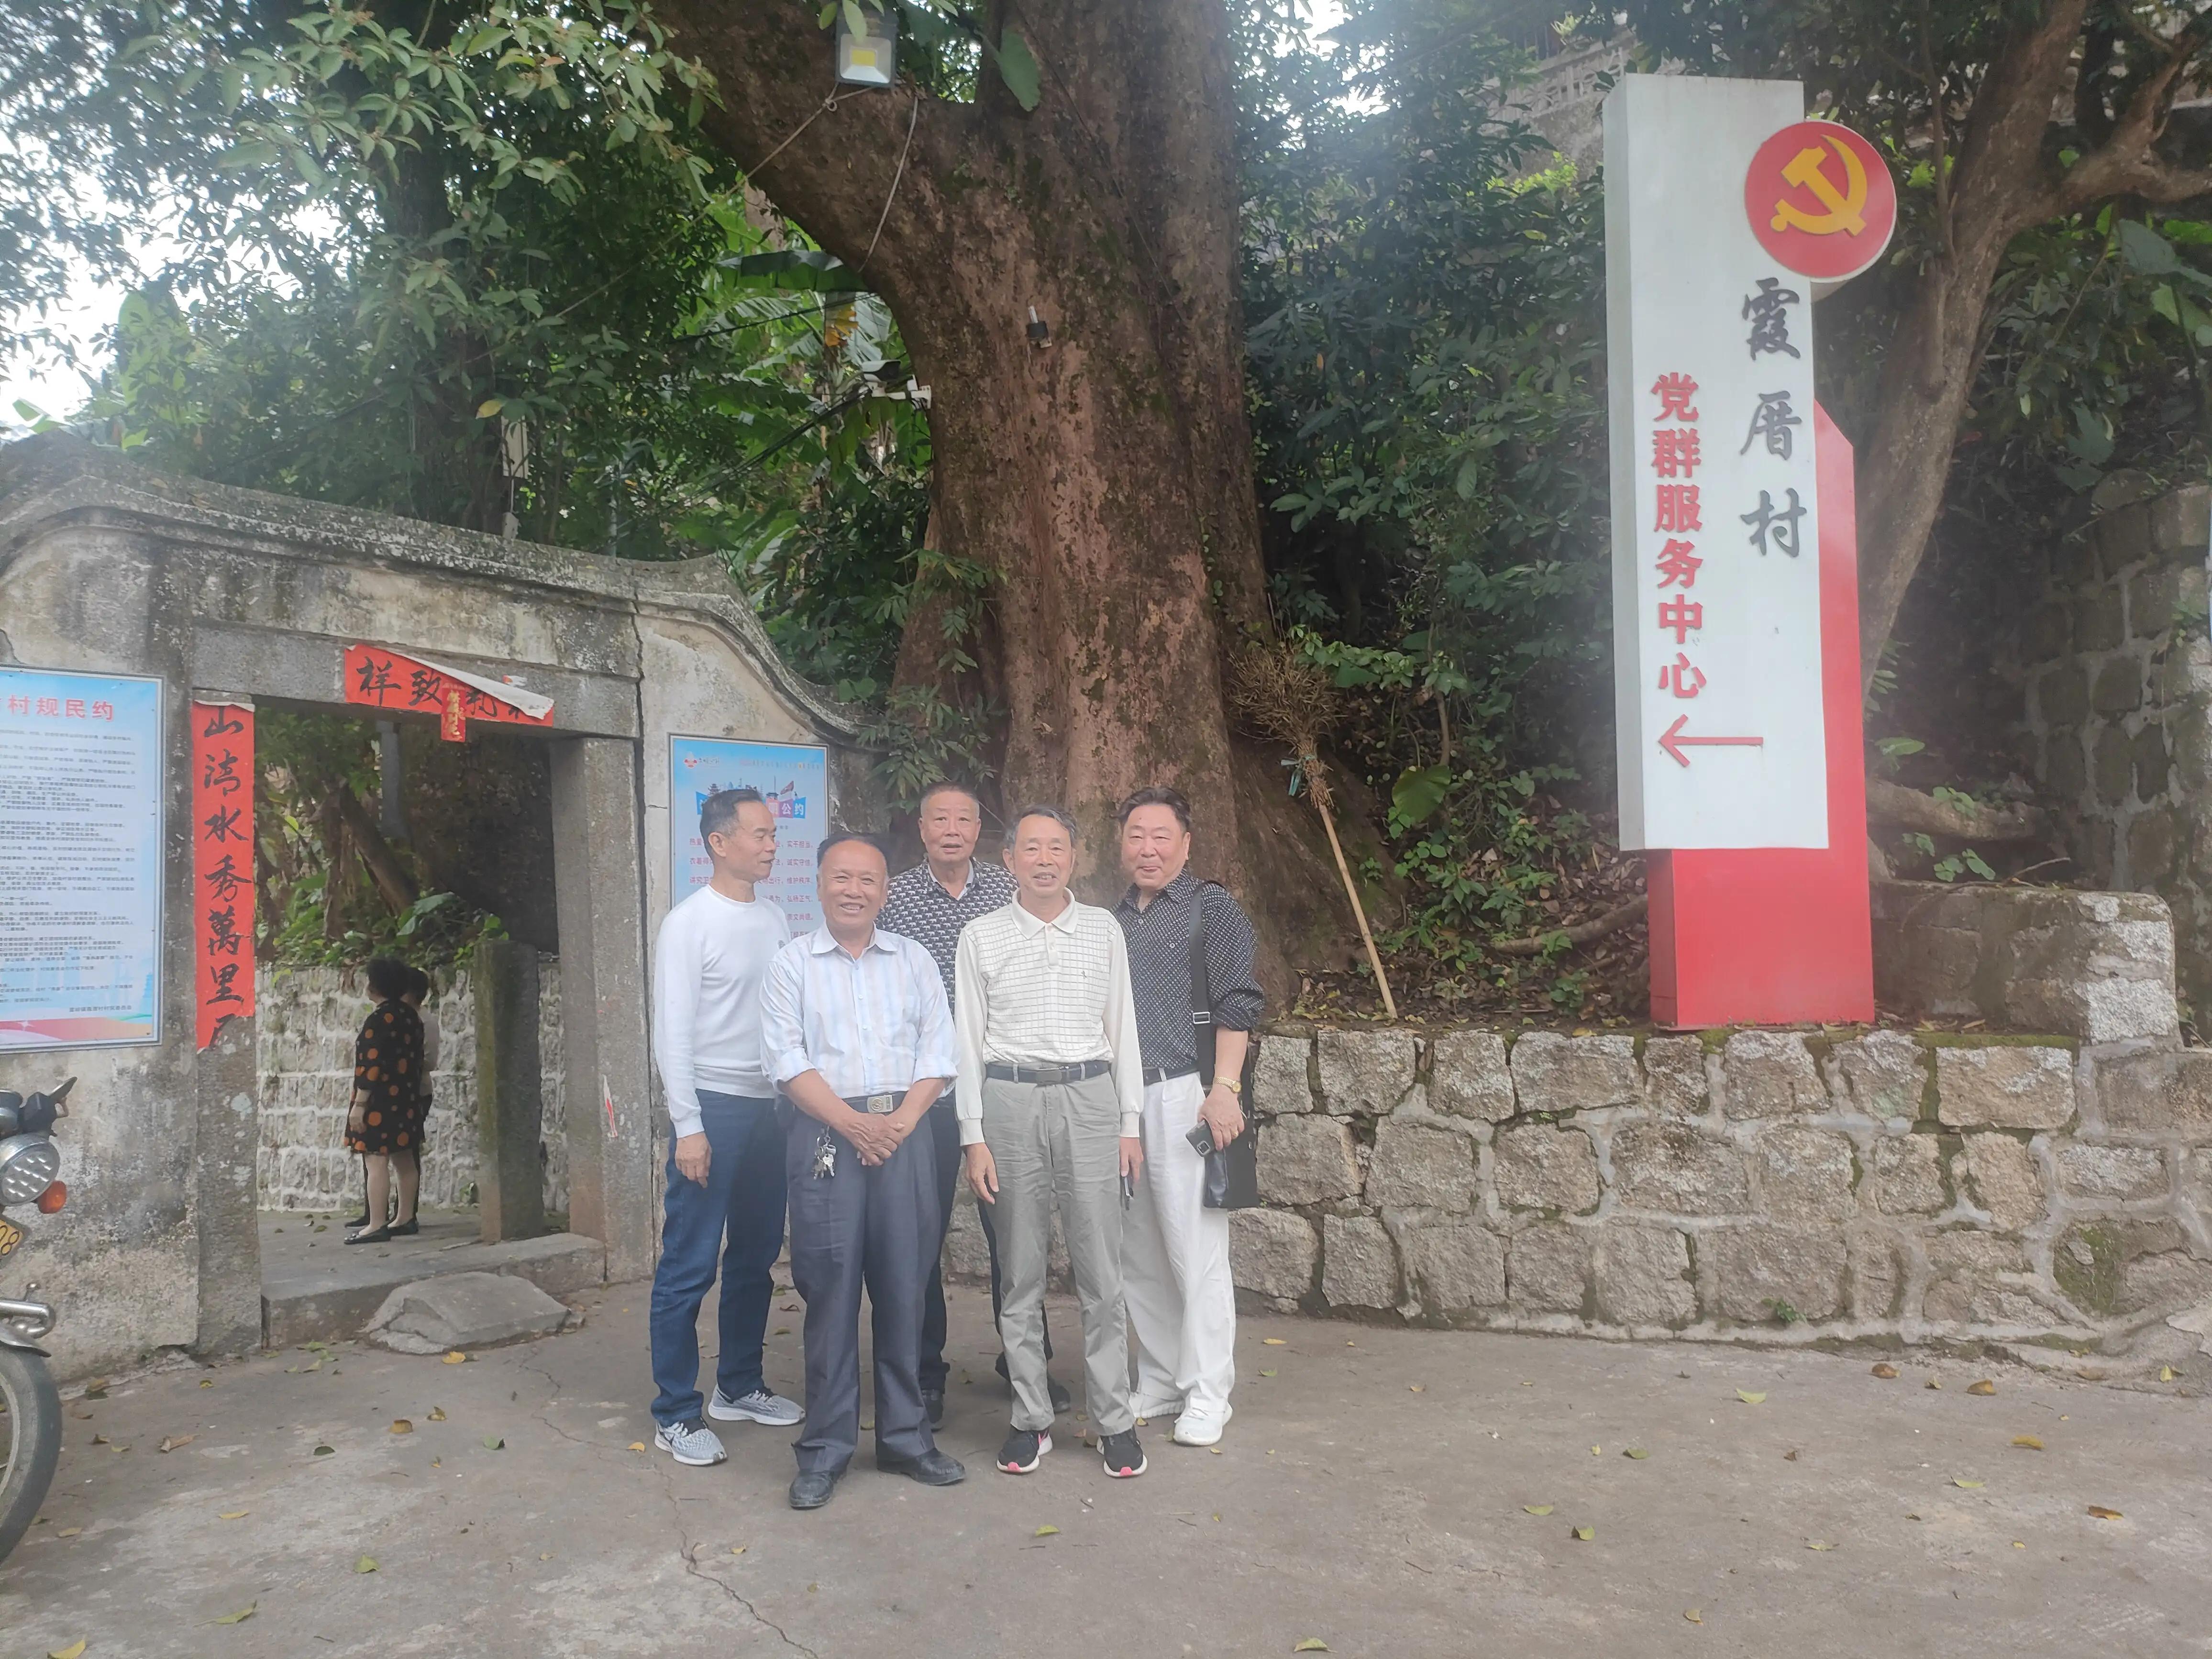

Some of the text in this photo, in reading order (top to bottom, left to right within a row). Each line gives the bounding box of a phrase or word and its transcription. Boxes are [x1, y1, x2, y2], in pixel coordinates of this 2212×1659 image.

[1651, 372, 1706, 698] 党群服务中心
[1740, 277, 1807, 558] 霞厝村
[7, 695, 114, 722] 村规民约
